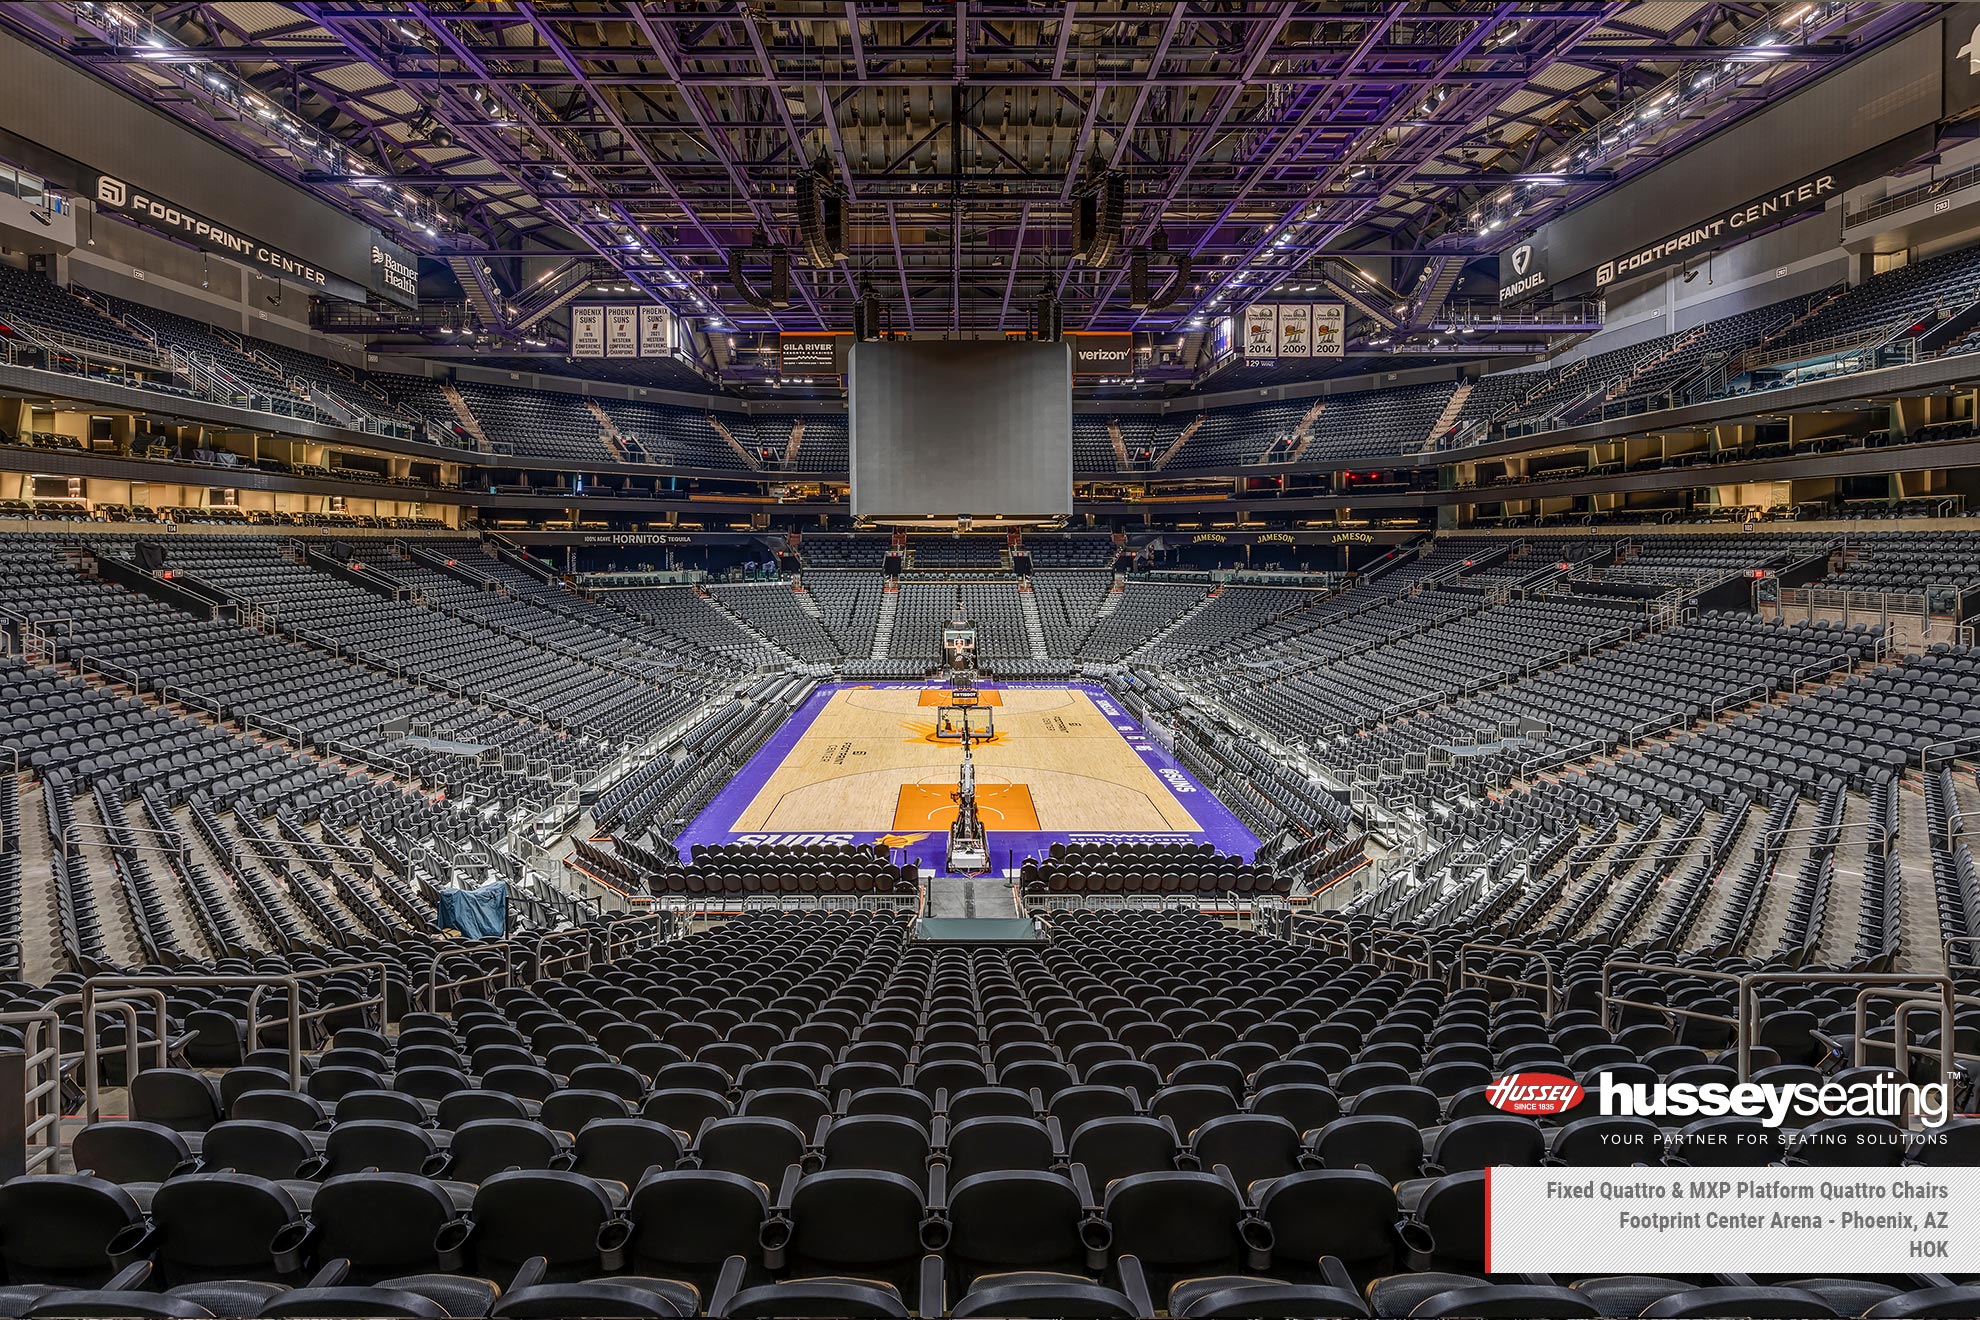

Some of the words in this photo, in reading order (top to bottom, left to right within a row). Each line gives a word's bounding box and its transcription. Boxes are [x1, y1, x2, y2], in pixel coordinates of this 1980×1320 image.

[1617, 219, 1726, 275] FOOTPRINT
[1729, 175, 1836, 228] CENTER
[131, 194, 254, 255] FOOTPRINT
[256, 248, 326, 286] CENTER
[384, 253, 419, 282] Banner
[384, 268, 416, 295] Health
[1500, 272, 1545, 301] FANDUEL
[1078, 349, 1125, 360] verizon
[1249, 345, 1272, 353] 2014
[1283, 345, 1306, 353] 2009
[612, 535, 666, 544] HORNITOS
[1192, 534, 1226, 543] JAMESON
[1257, 533, 1294, 544] JAMESON
[1331, 533, 1373, 544] JAMESON
